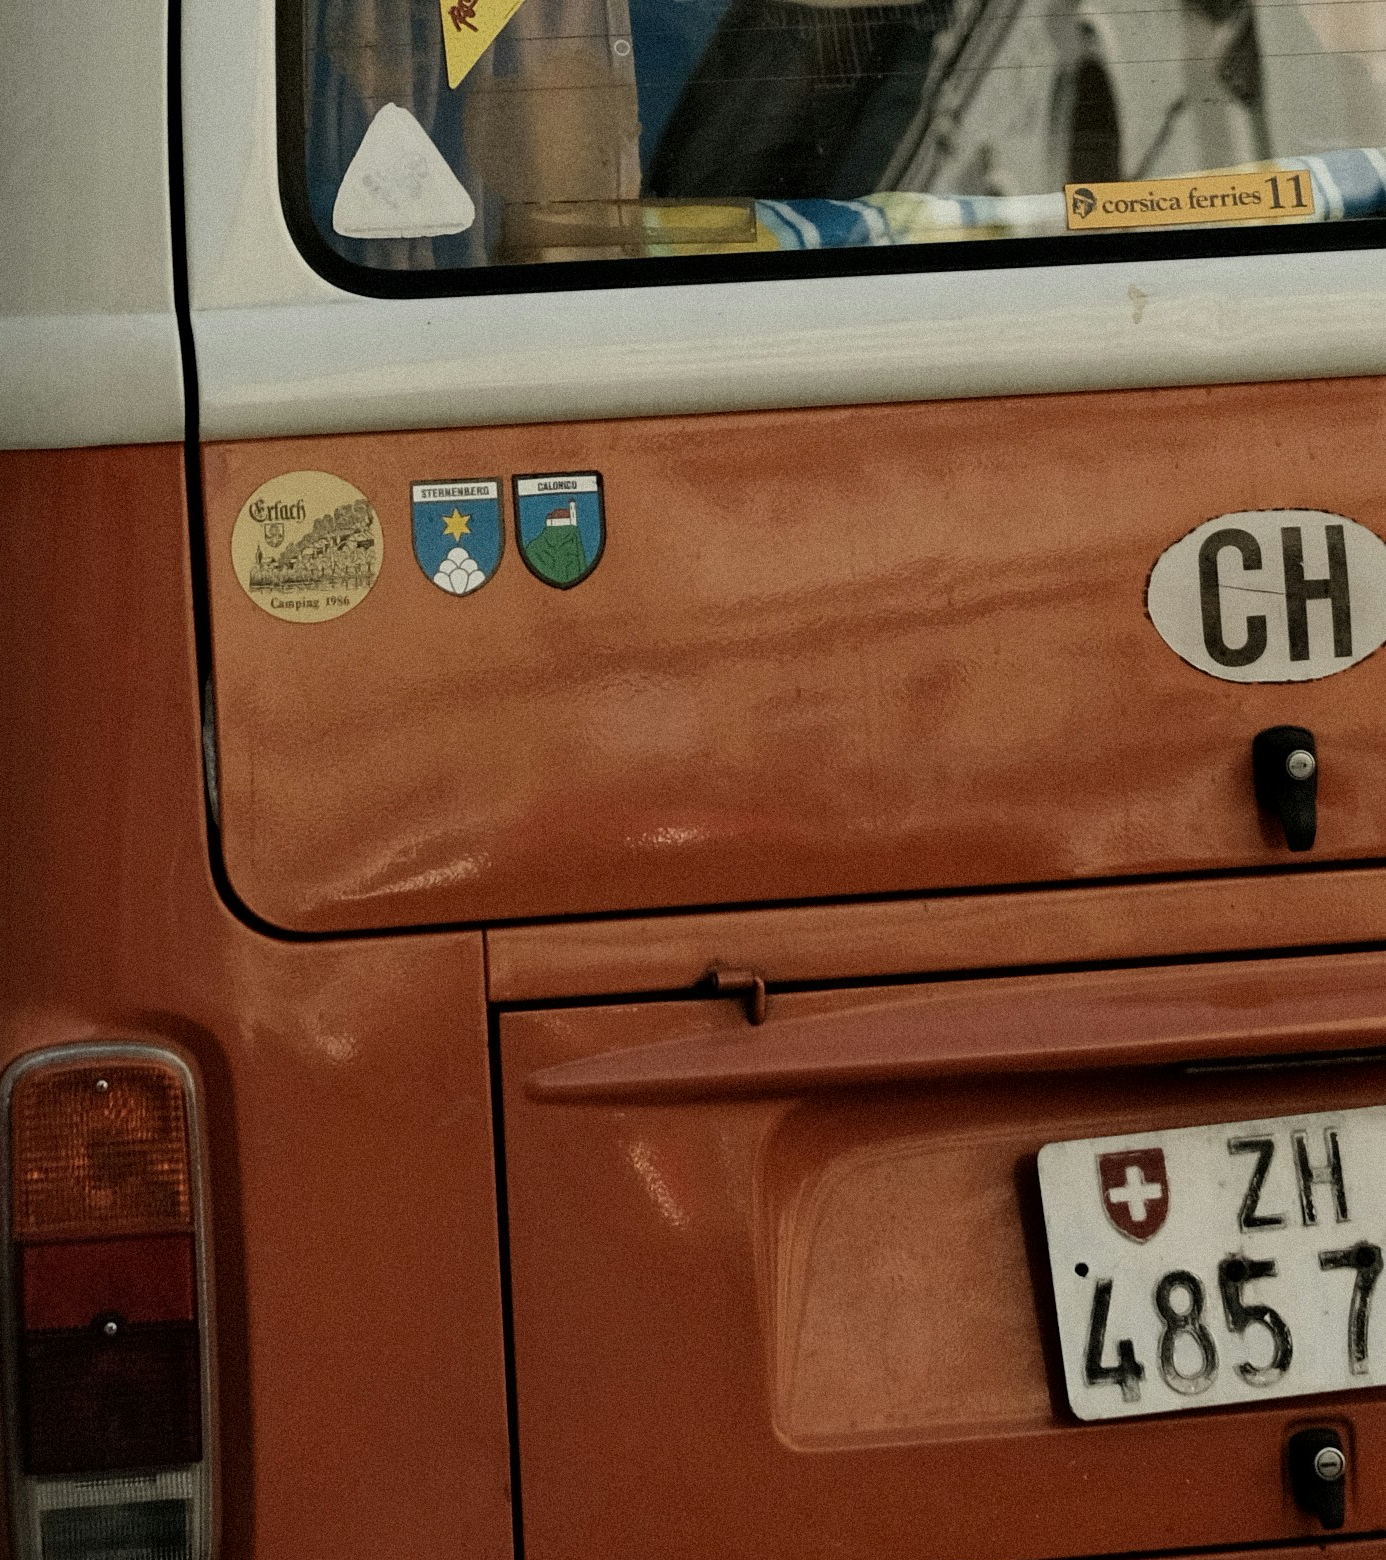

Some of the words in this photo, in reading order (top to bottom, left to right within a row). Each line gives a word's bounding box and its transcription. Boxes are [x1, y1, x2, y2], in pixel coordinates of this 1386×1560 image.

[1101, 191, 1182, 214] corsica
[1187, 186, 1262, 210] ferries
[1264, 174, 1308, 210] 11
[420, 486, 490, 499] STERNENBERG
[270, 596, 320, 611] Camping
[324, 594, 351, 607] 1986
[1198, 523, 1354, 668] CH
[1226, 1128, 1351, 1234] ZH
